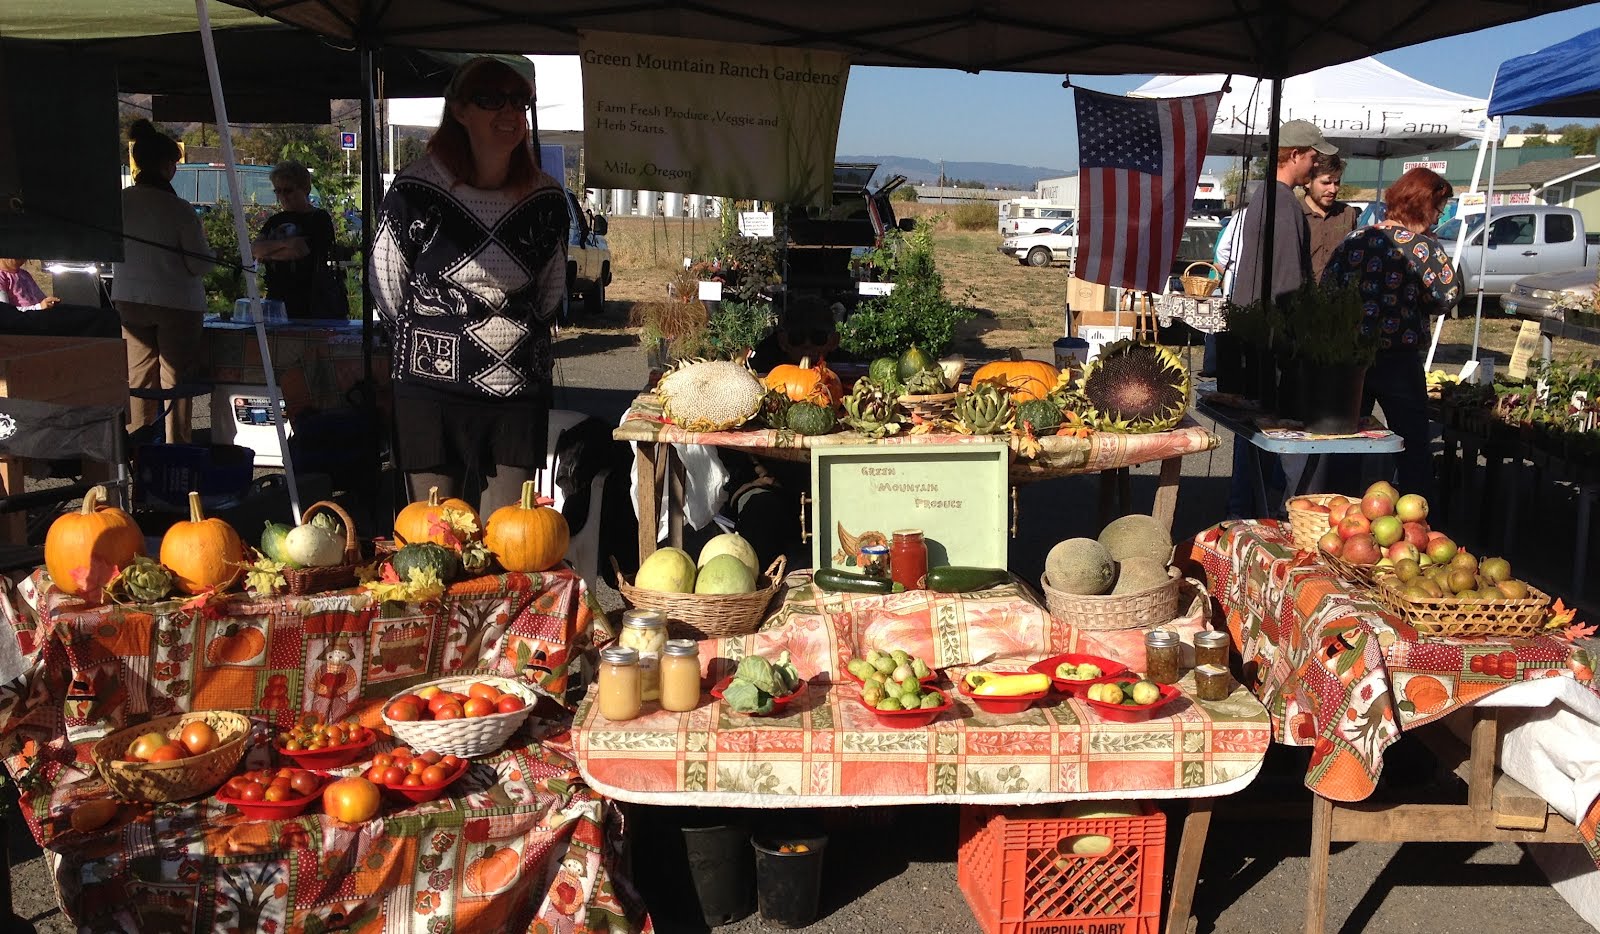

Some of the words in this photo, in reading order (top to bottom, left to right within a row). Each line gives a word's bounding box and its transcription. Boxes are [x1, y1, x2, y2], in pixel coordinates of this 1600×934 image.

[583, 49, 632, 68] Green
[635, 53, 715, 75] Mountain
[719, 61, 770, 80] Ranch
[773, 66, 840, 85] Gardens
[597, 100, 626, 114] Farm
[630, 103, 661, 117] Fresh
[664, 106, 709, 122] Produce
[757, 115, 779, 128] and
[597, 118, 626, 131] Herb
[1380, 111, 1449, 134] Farm
[603, 160, 636, 175] Milo
[861, 466, 896, 476] GREEN
[878, 482, 939, 493] MOUNTAIN
[914, 498, 963, 509] PRODUCE
